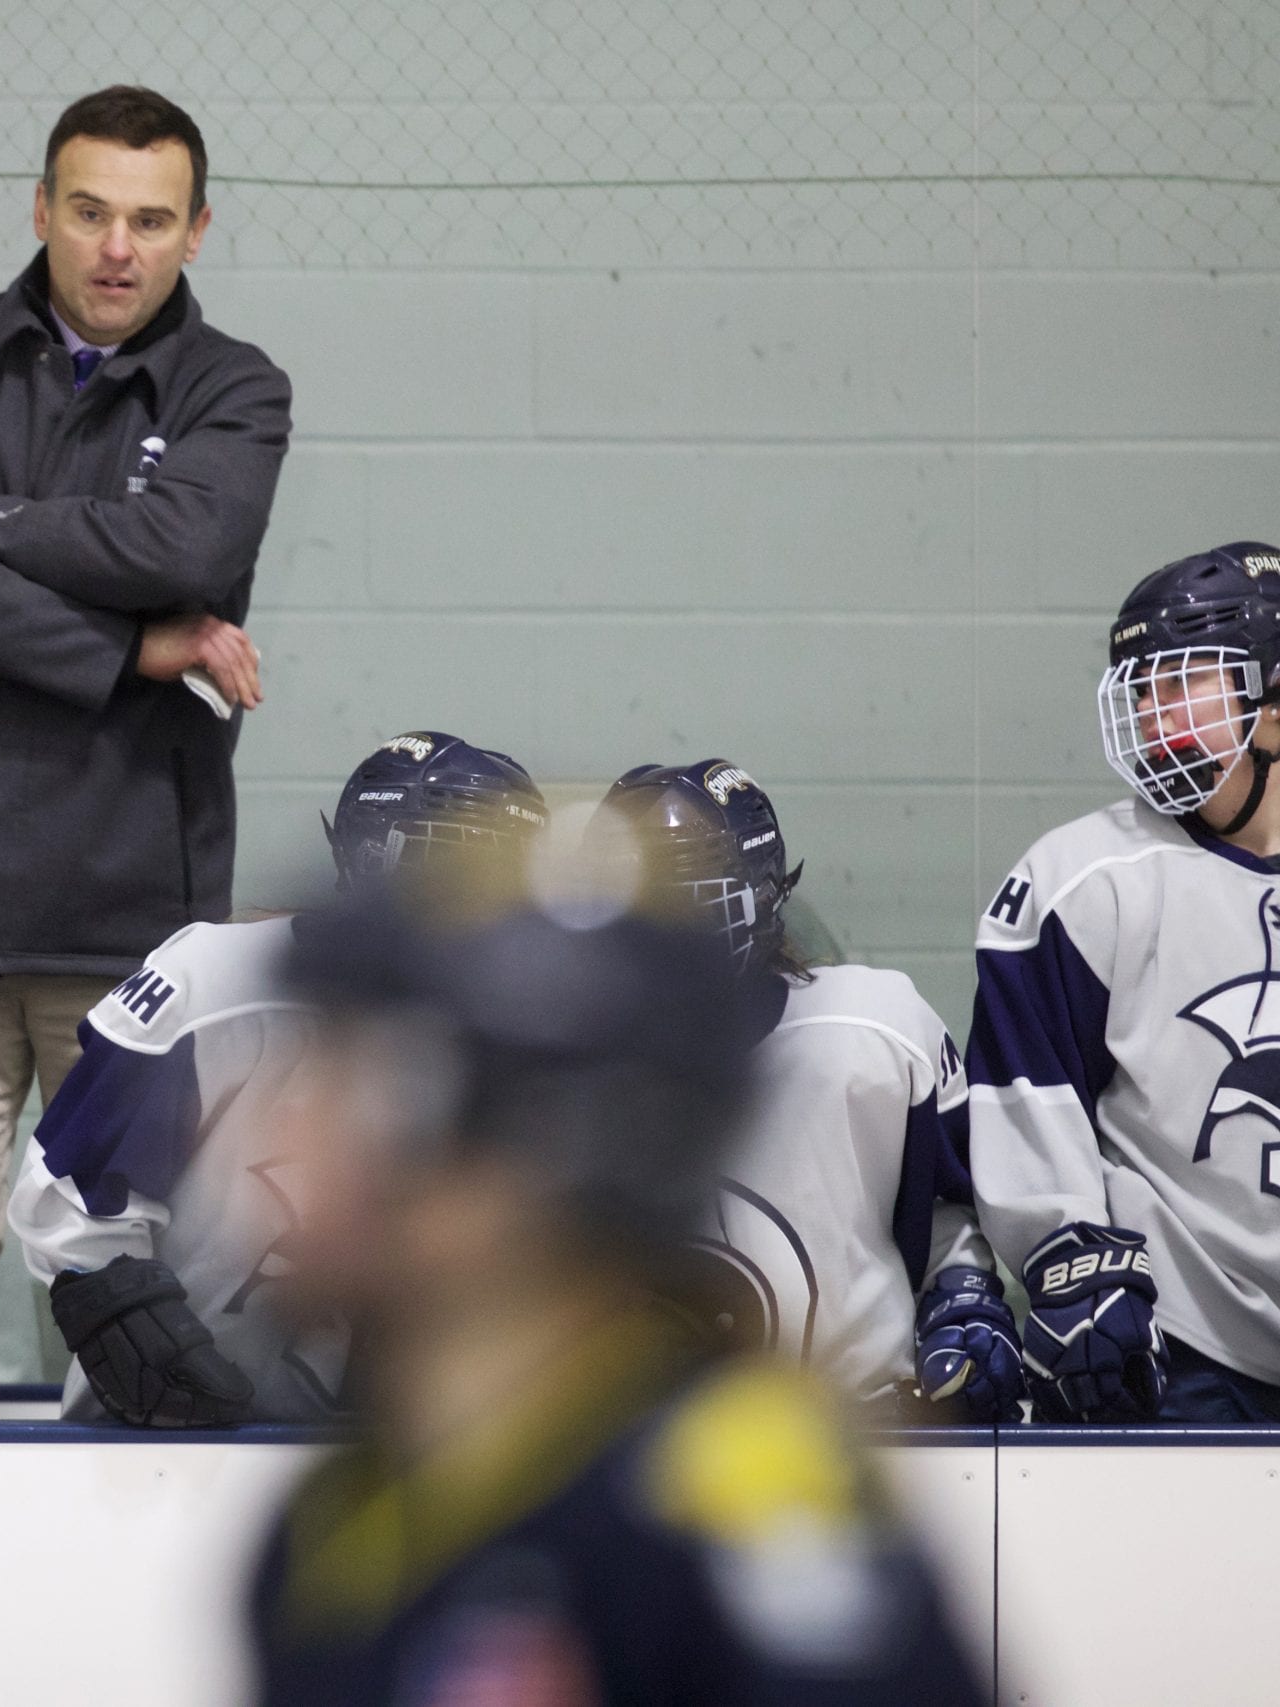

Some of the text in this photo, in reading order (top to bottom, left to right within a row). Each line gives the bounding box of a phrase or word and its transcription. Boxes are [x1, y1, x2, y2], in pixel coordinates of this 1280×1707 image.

[359, 792, 404, 801] BAUER
[743, 830, 776, 850] BAUER
[989, 876, 1030, 926] H
